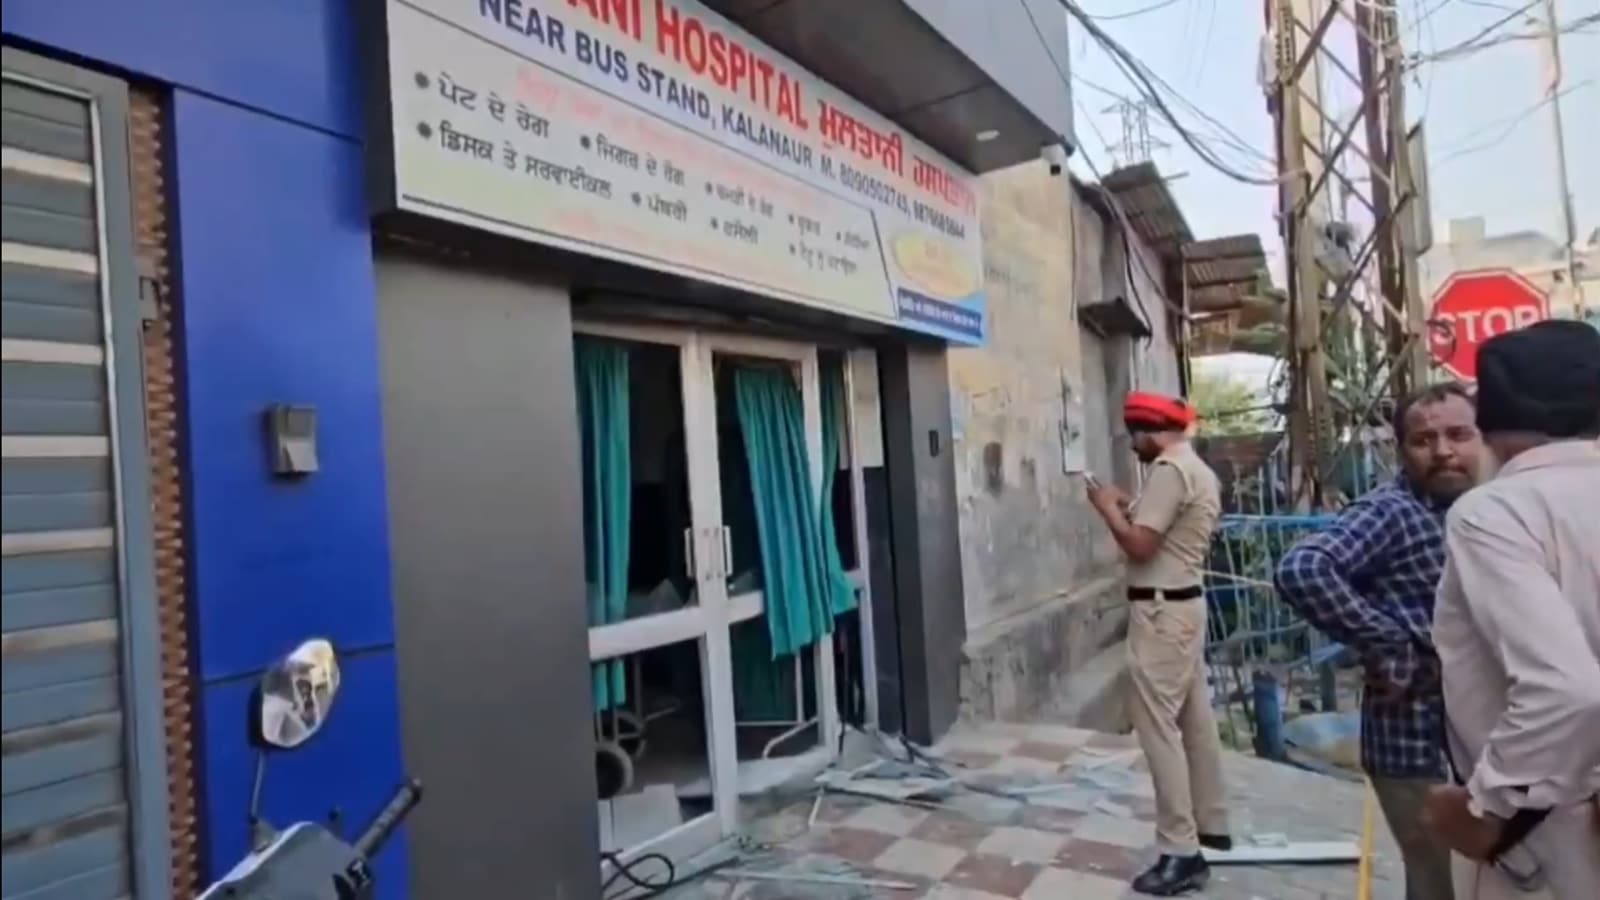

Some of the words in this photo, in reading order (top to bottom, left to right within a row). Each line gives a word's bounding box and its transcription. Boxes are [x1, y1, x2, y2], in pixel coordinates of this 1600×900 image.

[479, 0, 566, 54] NEAR
[575, 30, 629, 82] BUS
[636, 62, 717, 129] STAND,
[722, 104, 812, 169] KALANAUR
[654, 0, 809, 130] HOSPITAL
[438, 71, 477, 111] ਪੇਟ
[488, 91, 505, 122] ਦੇ
[515, 103, 550, 138] ਰੋਗ
[817, 98, 904, 178] ਮੁਲਤਾਨੀ
[439, 119, 494, 162] ਡਿਸਕ
[503, 141, 518, 170] ਤੇ
[1433, 304, 1540, 345] STOP
